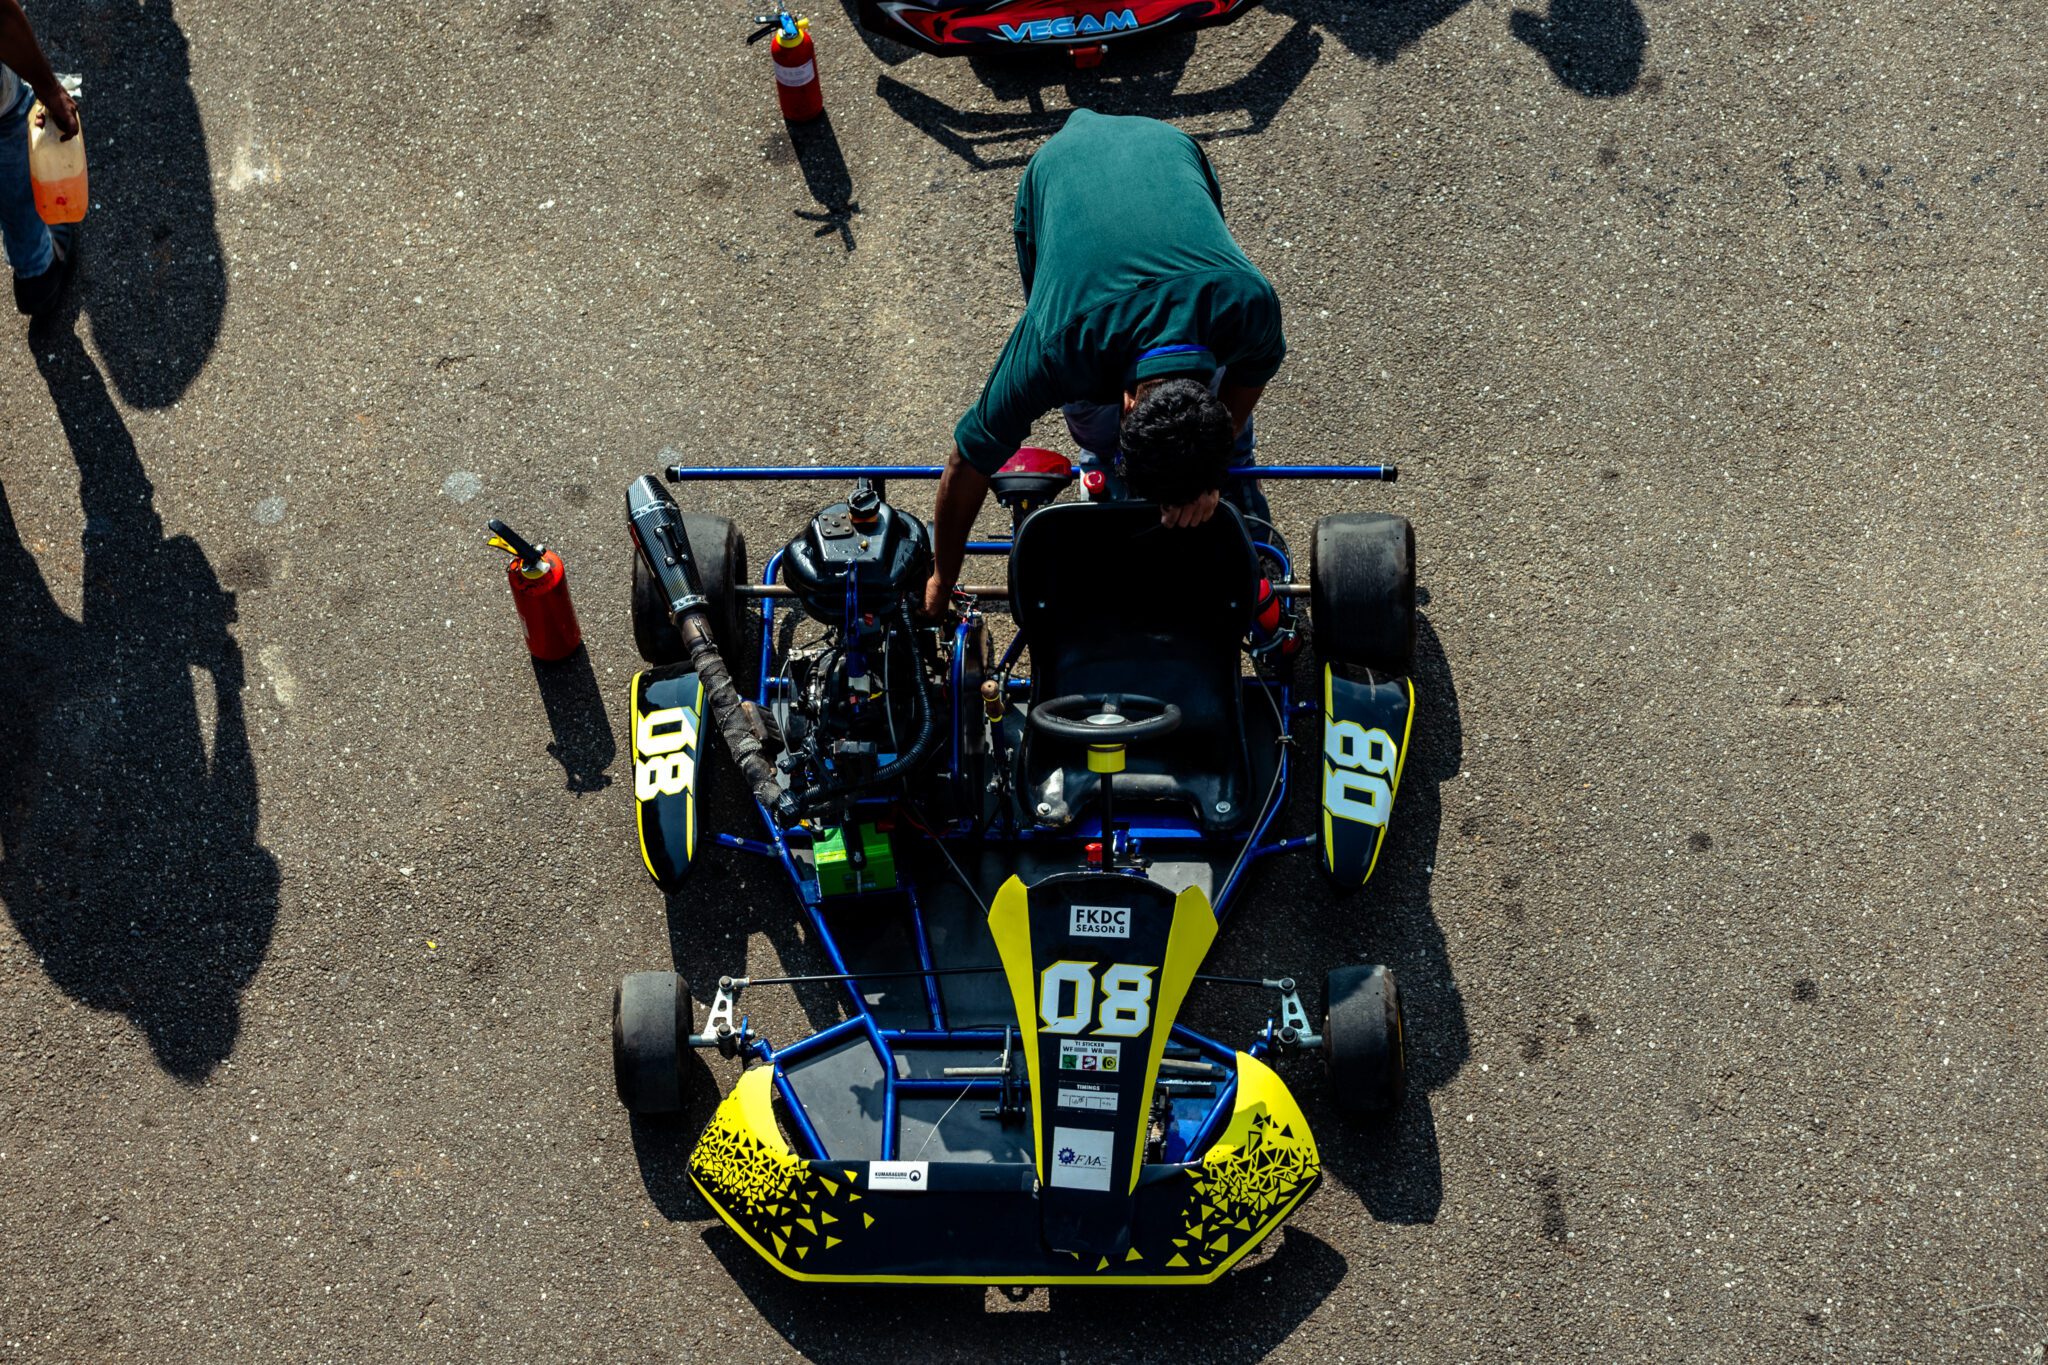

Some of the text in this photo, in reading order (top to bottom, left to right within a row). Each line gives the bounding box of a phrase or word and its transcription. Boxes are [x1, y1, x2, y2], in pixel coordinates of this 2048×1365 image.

[998, 9, 1139, 43] VEGAM
[635, 705, 700, 802] 08
[1322, 719, 1397, 832] 08
[1075, 909, 1126, 925] FKDC
[1075, 924, 1125, 934] SEASON 8
[1038, 960, 1159, 1037] 08
